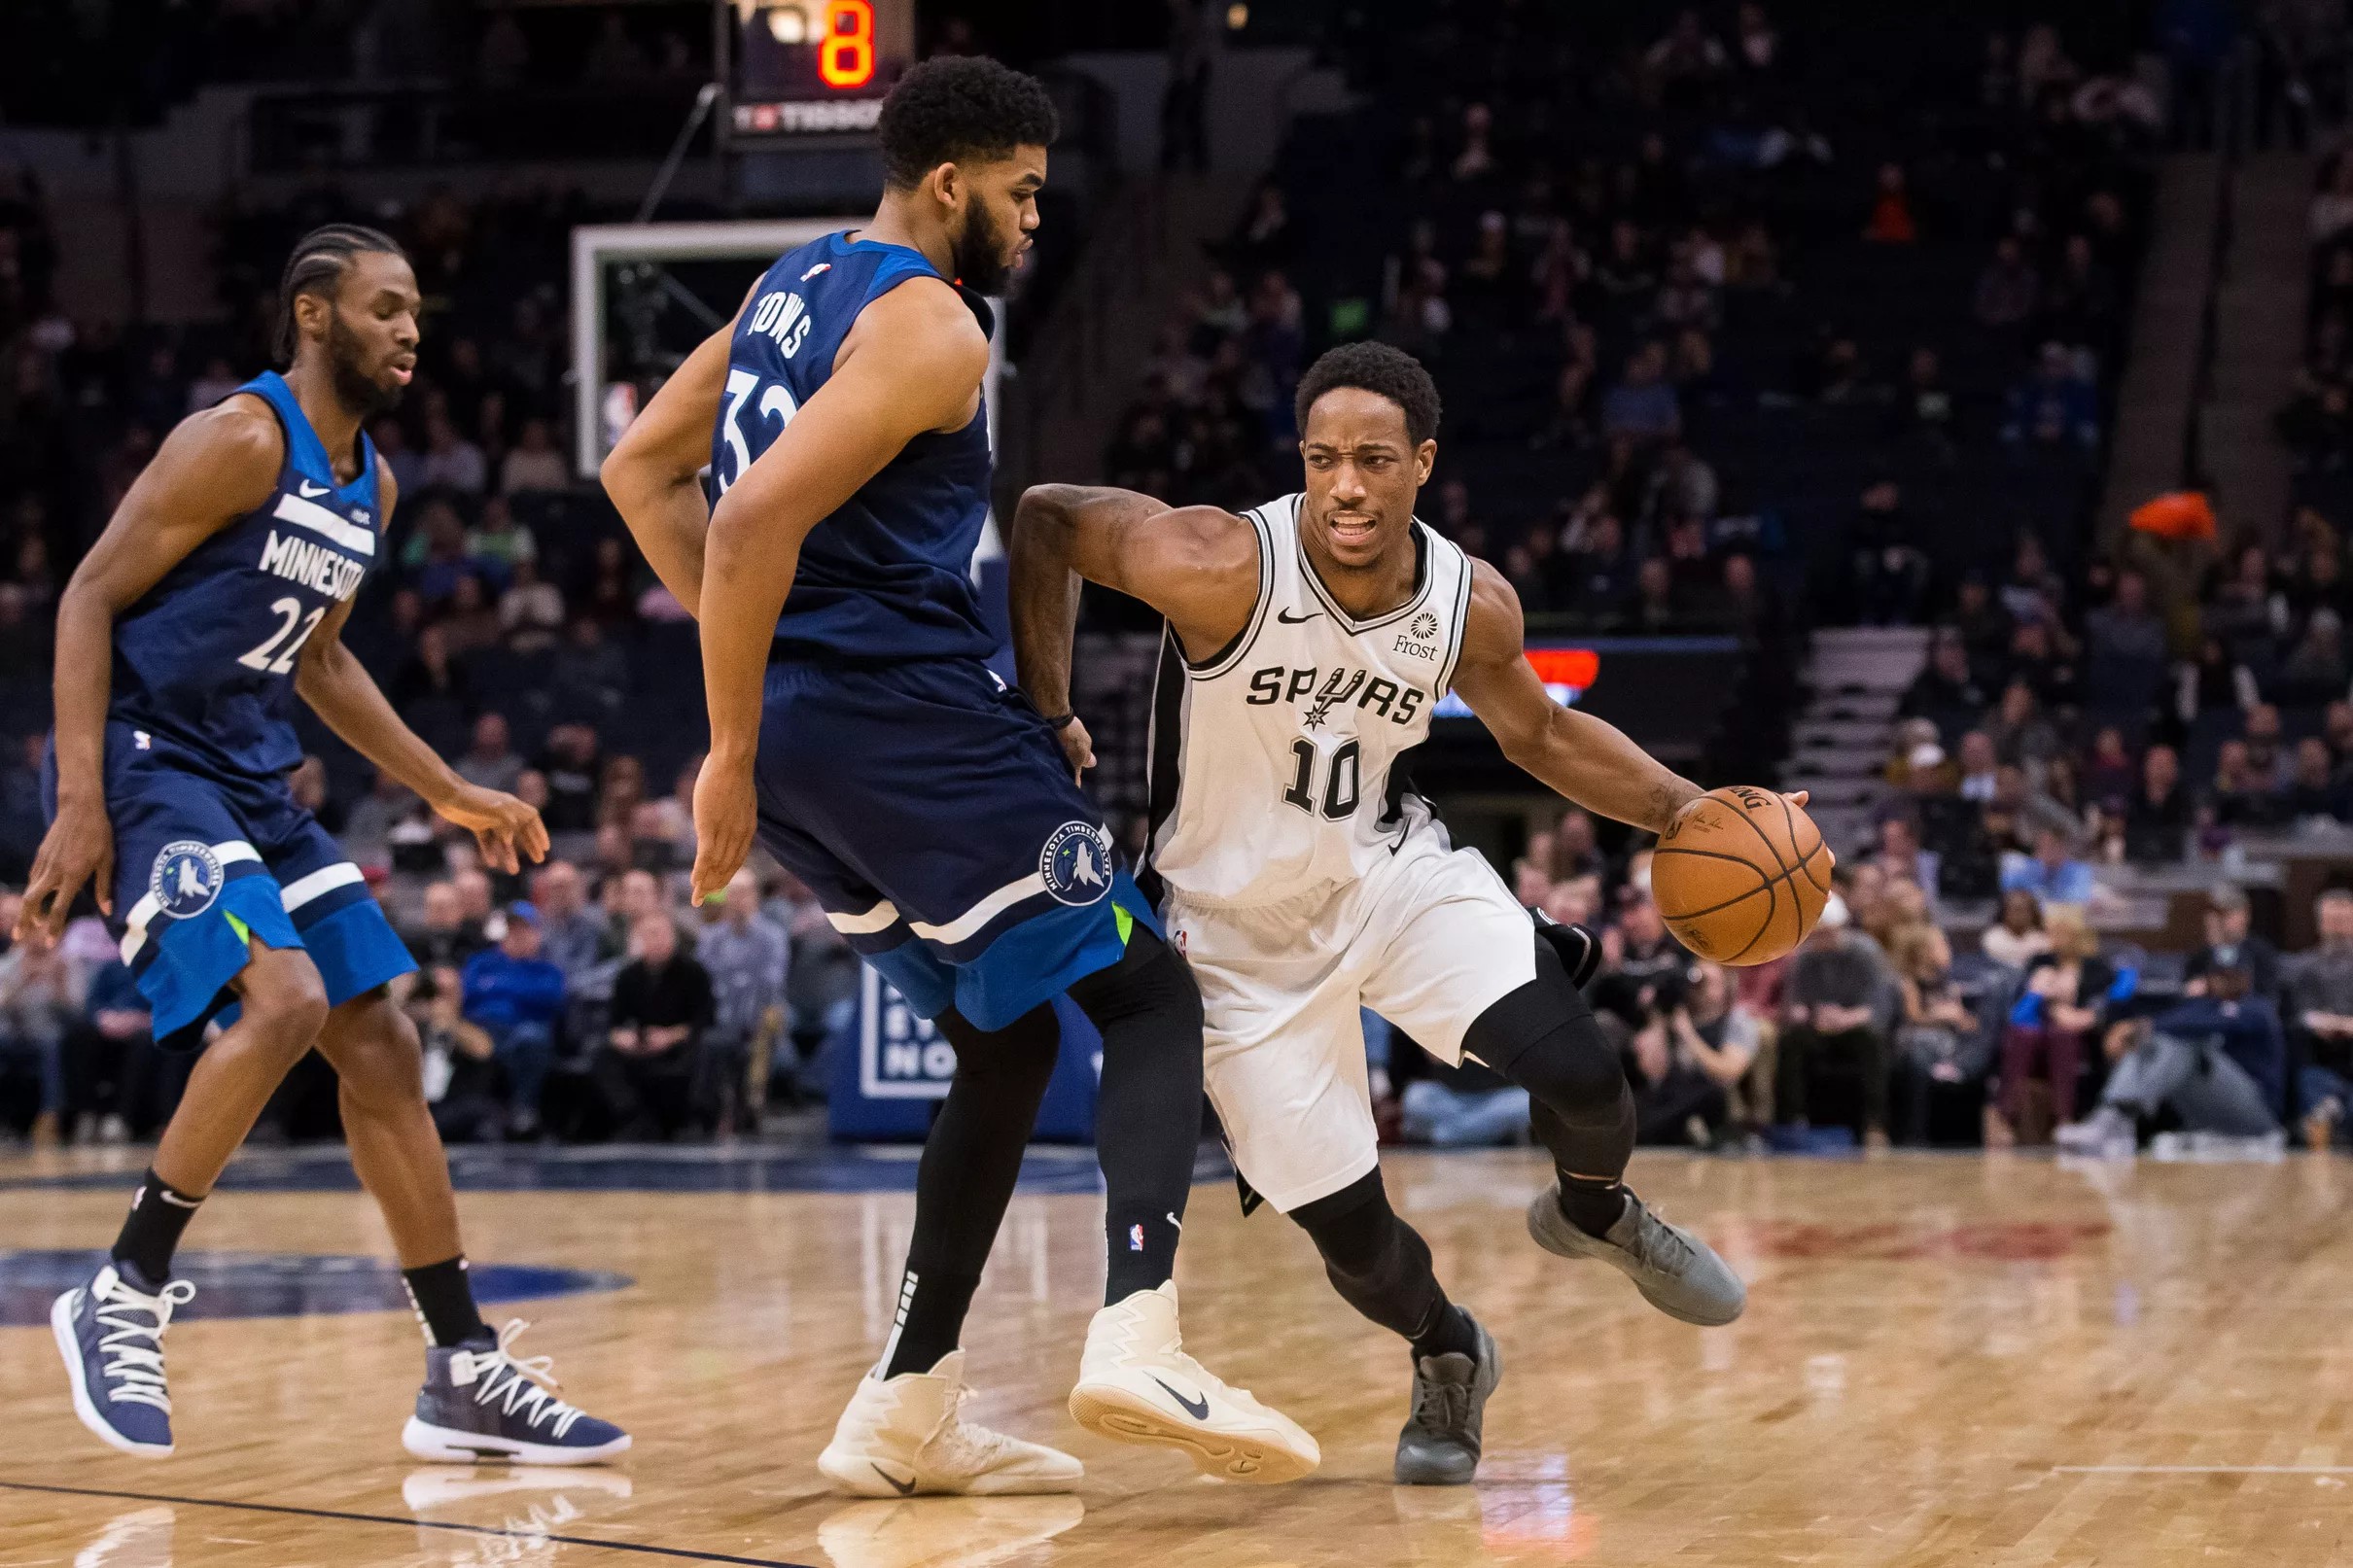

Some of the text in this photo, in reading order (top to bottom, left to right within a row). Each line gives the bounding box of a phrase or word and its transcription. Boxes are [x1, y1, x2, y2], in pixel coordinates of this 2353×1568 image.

[818, 0, 875, 88] 8
[259, 530, 366, 602] MINNESOT
[237, 597, 326, 674] 22
[1392, 635, 1438, 662] Frost
[1246, 665, 1424, 727] SPURS
[1282, 736, 1361, 822] 10
[1043, 825, 1110, 890] MINNESOTA TIMBERWOLVES
